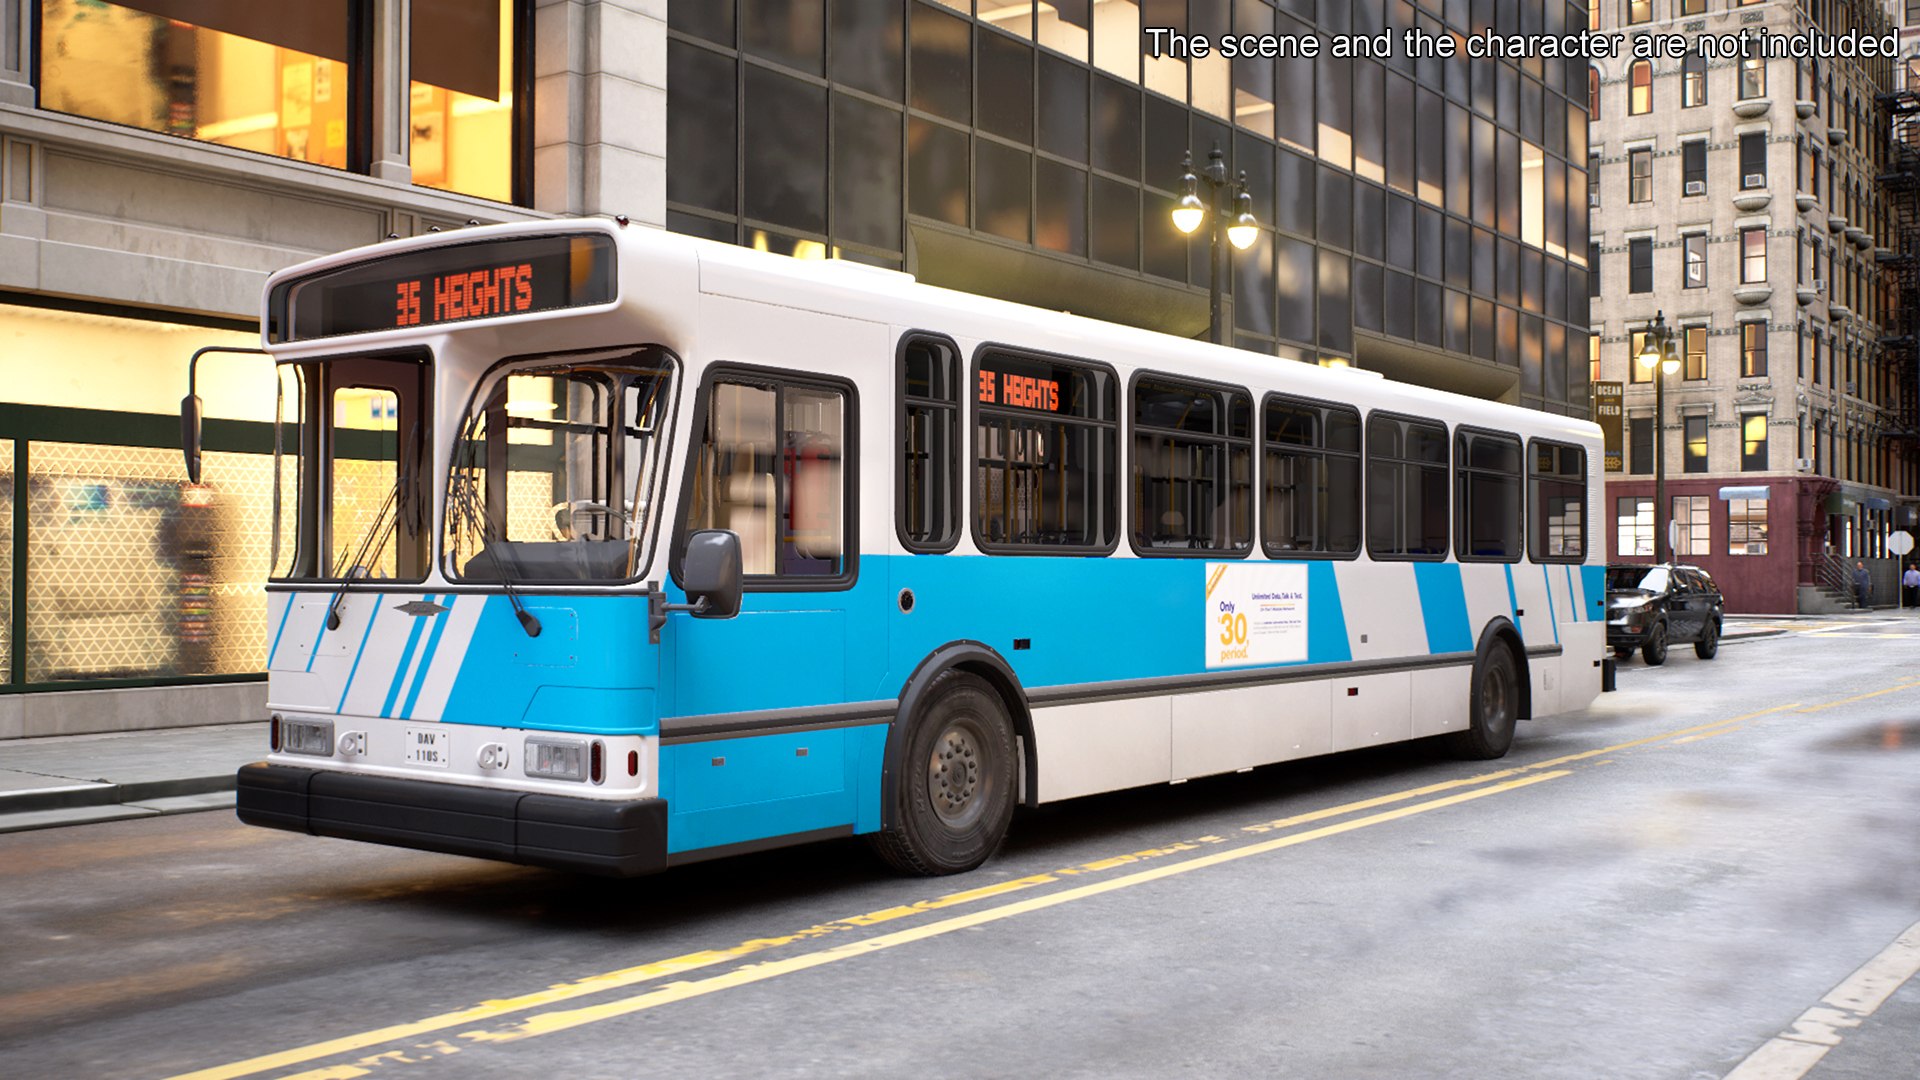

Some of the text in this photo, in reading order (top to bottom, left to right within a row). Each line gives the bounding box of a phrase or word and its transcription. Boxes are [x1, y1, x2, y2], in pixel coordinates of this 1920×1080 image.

[396, 264, 533, 326] 35 HEIGHTS
[979, 369, 1059, 411] 35 HEIGHTS
[1597, 386, 1622, 395] OCEAN
[1598, 405, 1621, 415] FIELD
[1219, 601, 1235, 614] Only
[417, 732, 436, 745] DAV
